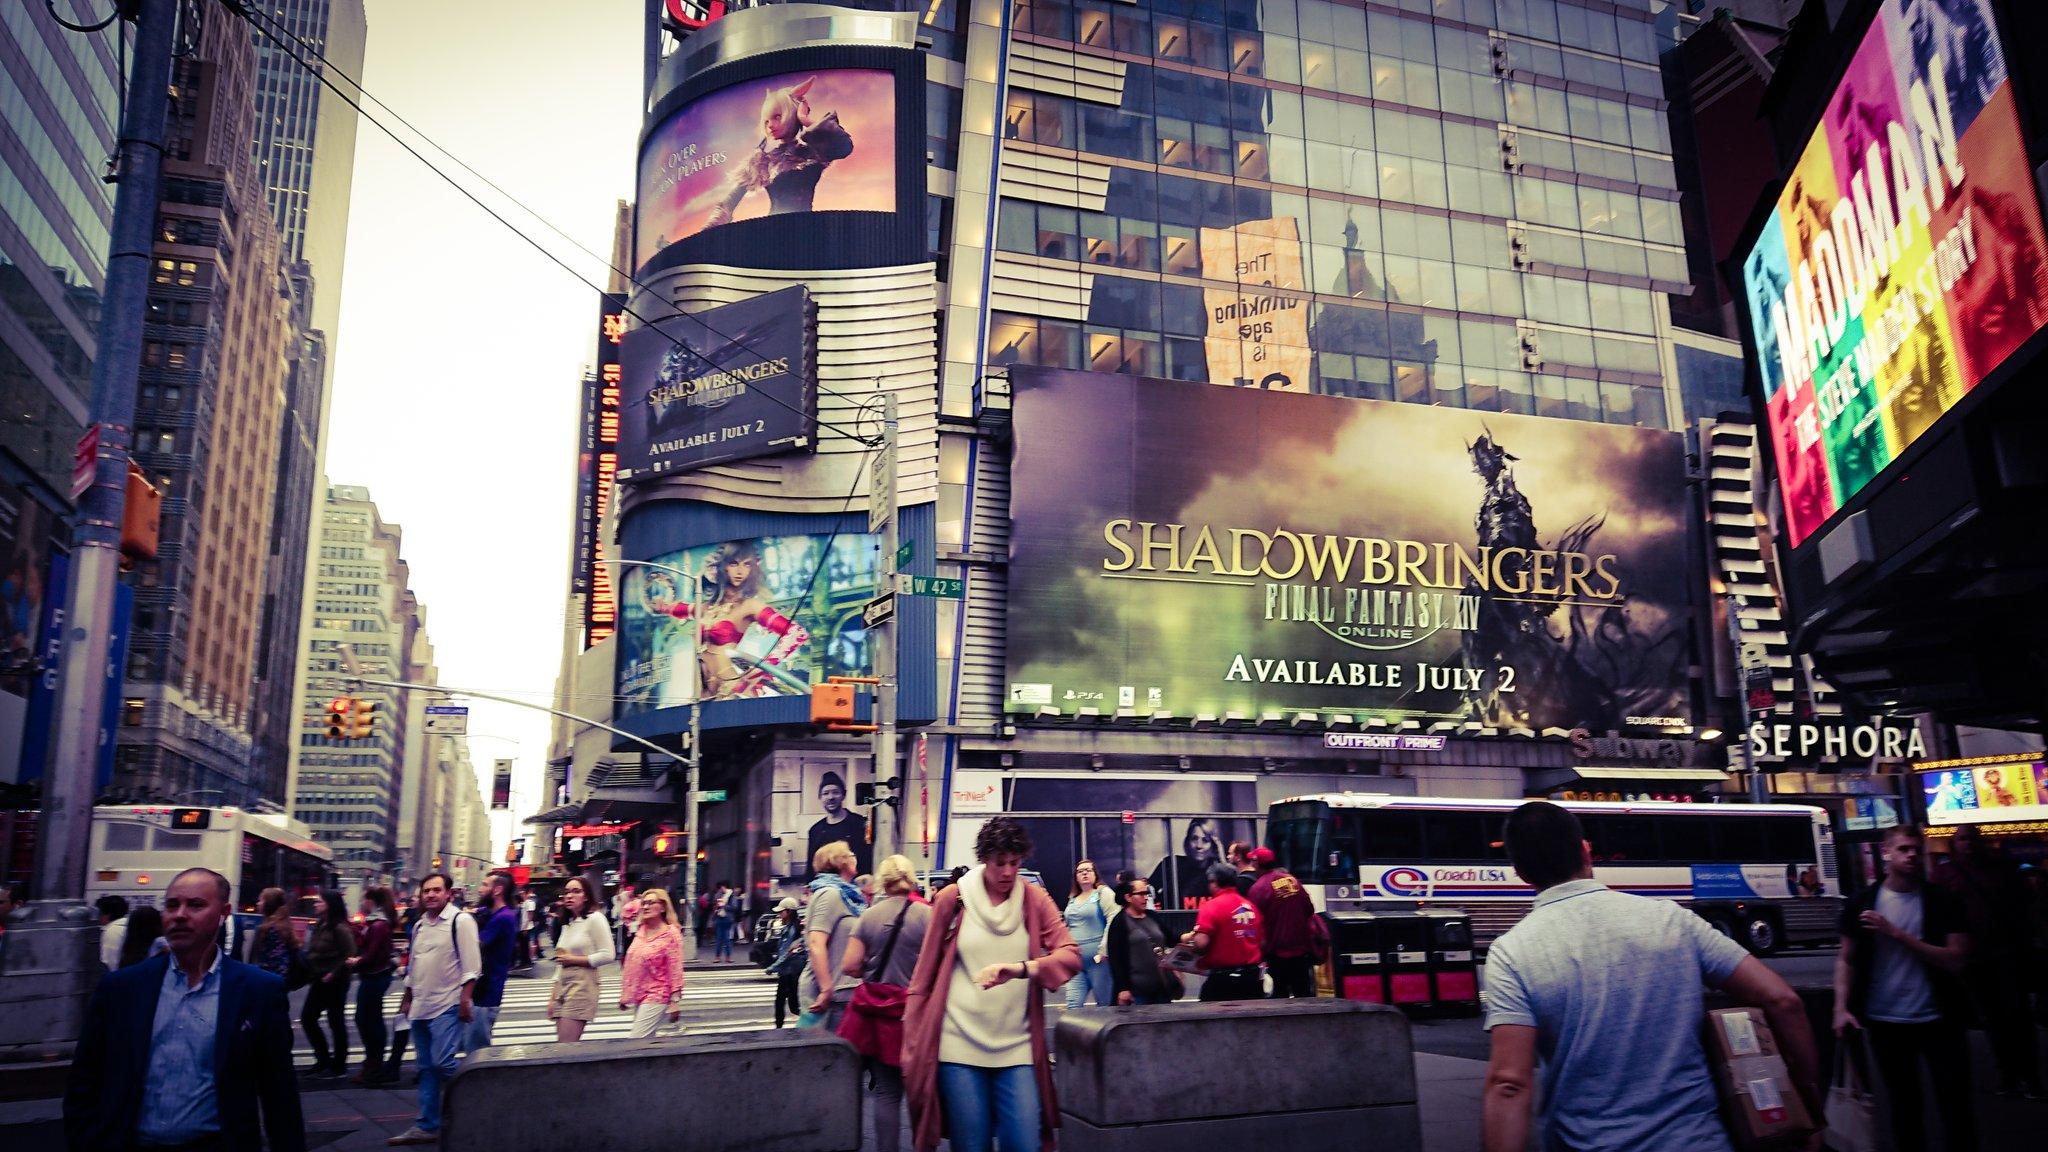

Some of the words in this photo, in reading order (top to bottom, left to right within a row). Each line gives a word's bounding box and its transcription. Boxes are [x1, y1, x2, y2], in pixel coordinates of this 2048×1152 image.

[668, 143, 697, 168] OVER
[677, 151, 728, 181] PLAYERS
[1772, 53, 1966, 403] MADDMAN
[649, 357, 788, 405] SHADOWBRINGERS
[649, 431, 716, 455] AVAILABLE
[721, 423, 752, 442] JULY
[755, 419, 765, 433] 2
[1103, 518, 1621, 599] SHADOWBRINGERS
[914, 579, 926, 593] W
[931, 580, 947, 595] 42
[1265, 583, 1335, 623] FINAL
[1453, 594, 1482, 632] XIV
[1337, 626, 1413, 640] ONLINE
[1224, 653, 1401, 688] AVAILABLE
[1415, 662, 1486, 693] JULY
[1498, 666, 1516, 692] 2
[1076, 692, 1104, 700] PS4
[1327, 734, 1399, 748] OUTFRONT
[1405, 737, 1442, 749] PRIME
[1569, 727, 1696, 768] Subway
[1750, 723, 1928, 758] SEPHORA
[1958, 770, 1979, 809] FROZEN
[1434, 868, 1476, 882] Coach
[1479, 869, 1507, 881] USA
